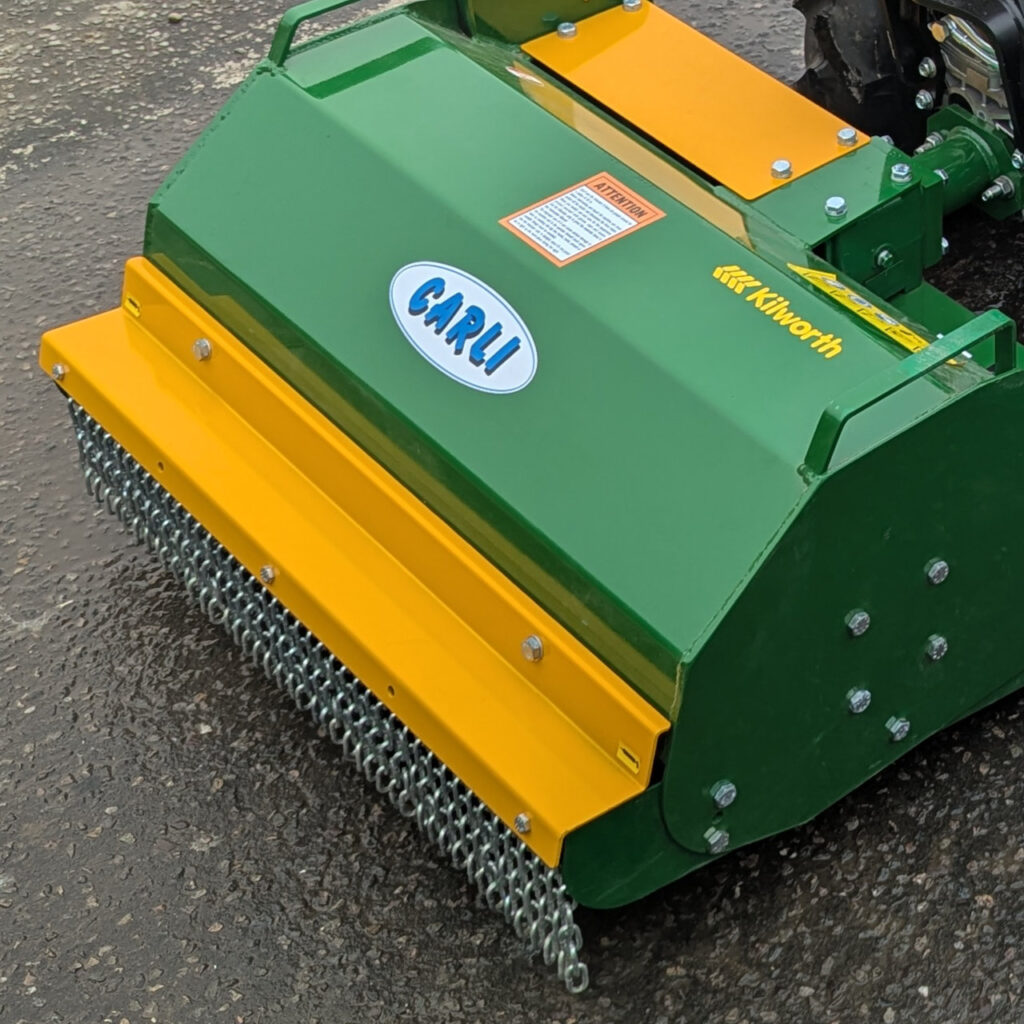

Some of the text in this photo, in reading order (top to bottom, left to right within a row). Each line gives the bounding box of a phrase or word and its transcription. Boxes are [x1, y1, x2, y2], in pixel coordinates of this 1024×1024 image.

[594, 182, 648, 219] ATTENTION
[408, 277, 521, 376] CARLI
[745, 287, 842, 358] Kilworth
